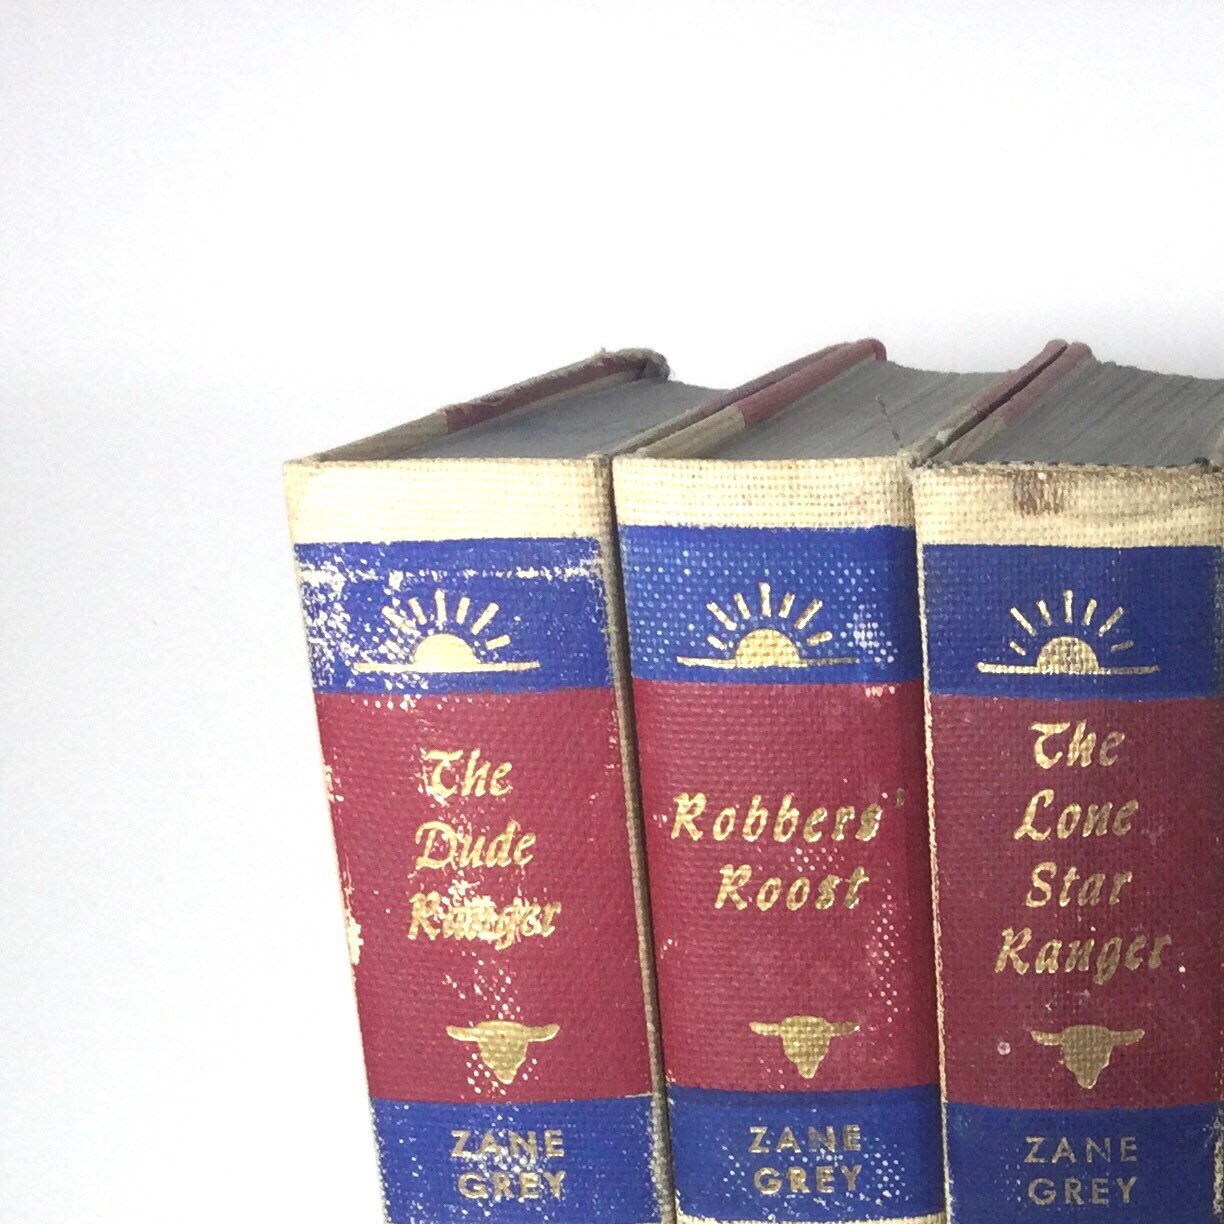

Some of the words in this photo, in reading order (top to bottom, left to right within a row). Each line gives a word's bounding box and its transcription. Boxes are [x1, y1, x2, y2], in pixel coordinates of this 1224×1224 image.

[1030, 721, 1125, 768] The
[423, 748, 512, 797] The
[1014, 788, 1139, 841] Lone
[415, 820, 536, 870] Dude
[715, 864, 869, 911] Roost
[1025, 862, 1133, 907] Star
[995, 927, 1172, 985] Ranger
[452, 1129, 565, 1158] ZANE
[749, 1125, 861, 1153] ZANE
[1025, 1136, 1137, 1164] ZANE
[458, 1171, 566, 1199] GREY
[754, 1165, 863, 1195] GREY
[1027, 1176, 1137, 1205] GREY
